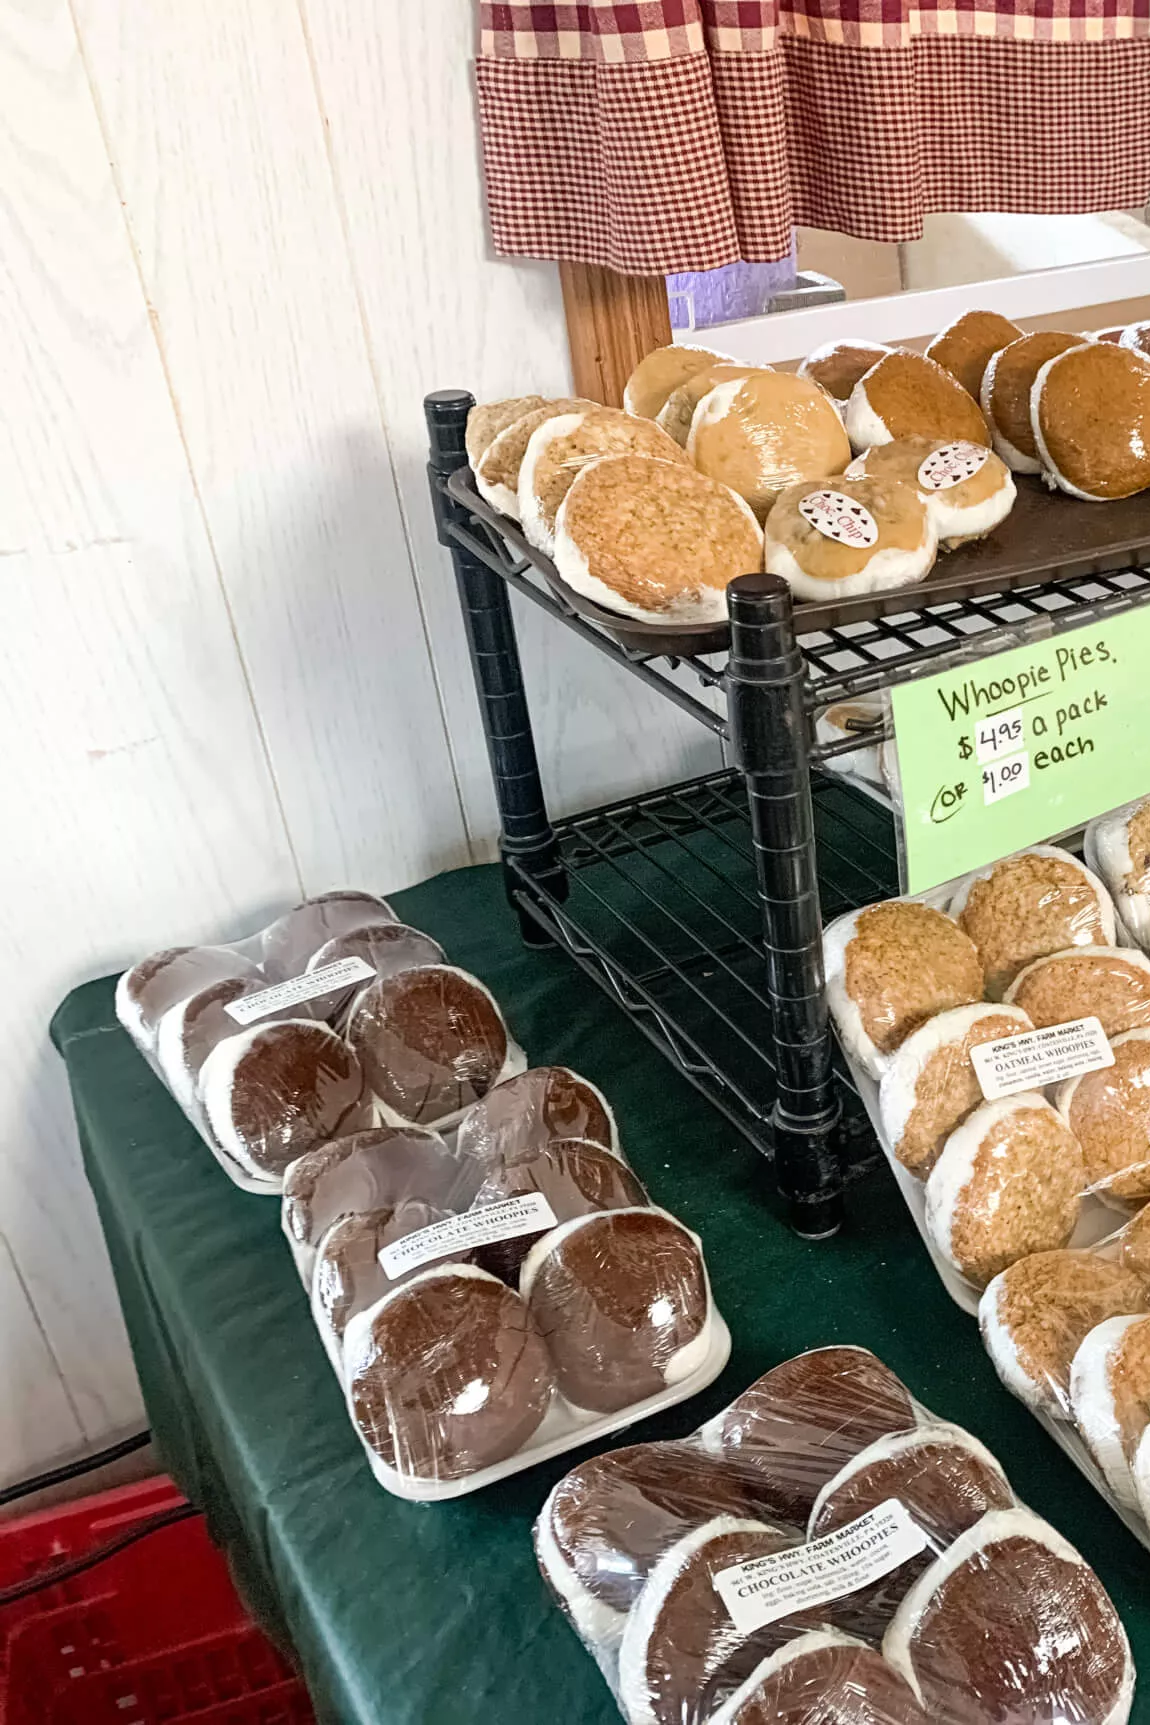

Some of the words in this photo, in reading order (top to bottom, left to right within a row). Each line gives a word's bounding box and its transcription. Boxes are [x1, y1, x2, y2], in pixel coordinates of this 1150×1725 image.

[837, 516, 863, 539] Chip
[937, 665, 1051, 722] Whoopie
[1032, 716, 1047, 736] a
[1055, 690, 1108, 735] pack
[940, 782, 968, 808] OR
[982, 762, 1022, 794] $1.00
[1033, 736, 1095, 770] each
[995, 1052, 1045, 1072] OATMEAL
[1045, 1040, 1096, 1057] WHOOPIES
[1037, 1032, 1056, 1041] FARM
[1057, 1024, 1085, 1036] MARKET
[738, 1561, 826, 1598] CHOCOLATE
[826, 1522, 898, 1566] WHOOPIES
[741, 1557, 777, 1572] KING'S
[805, 1538, 834, 1554] FARM
[835, 1514, 875, 1540] MARKET
